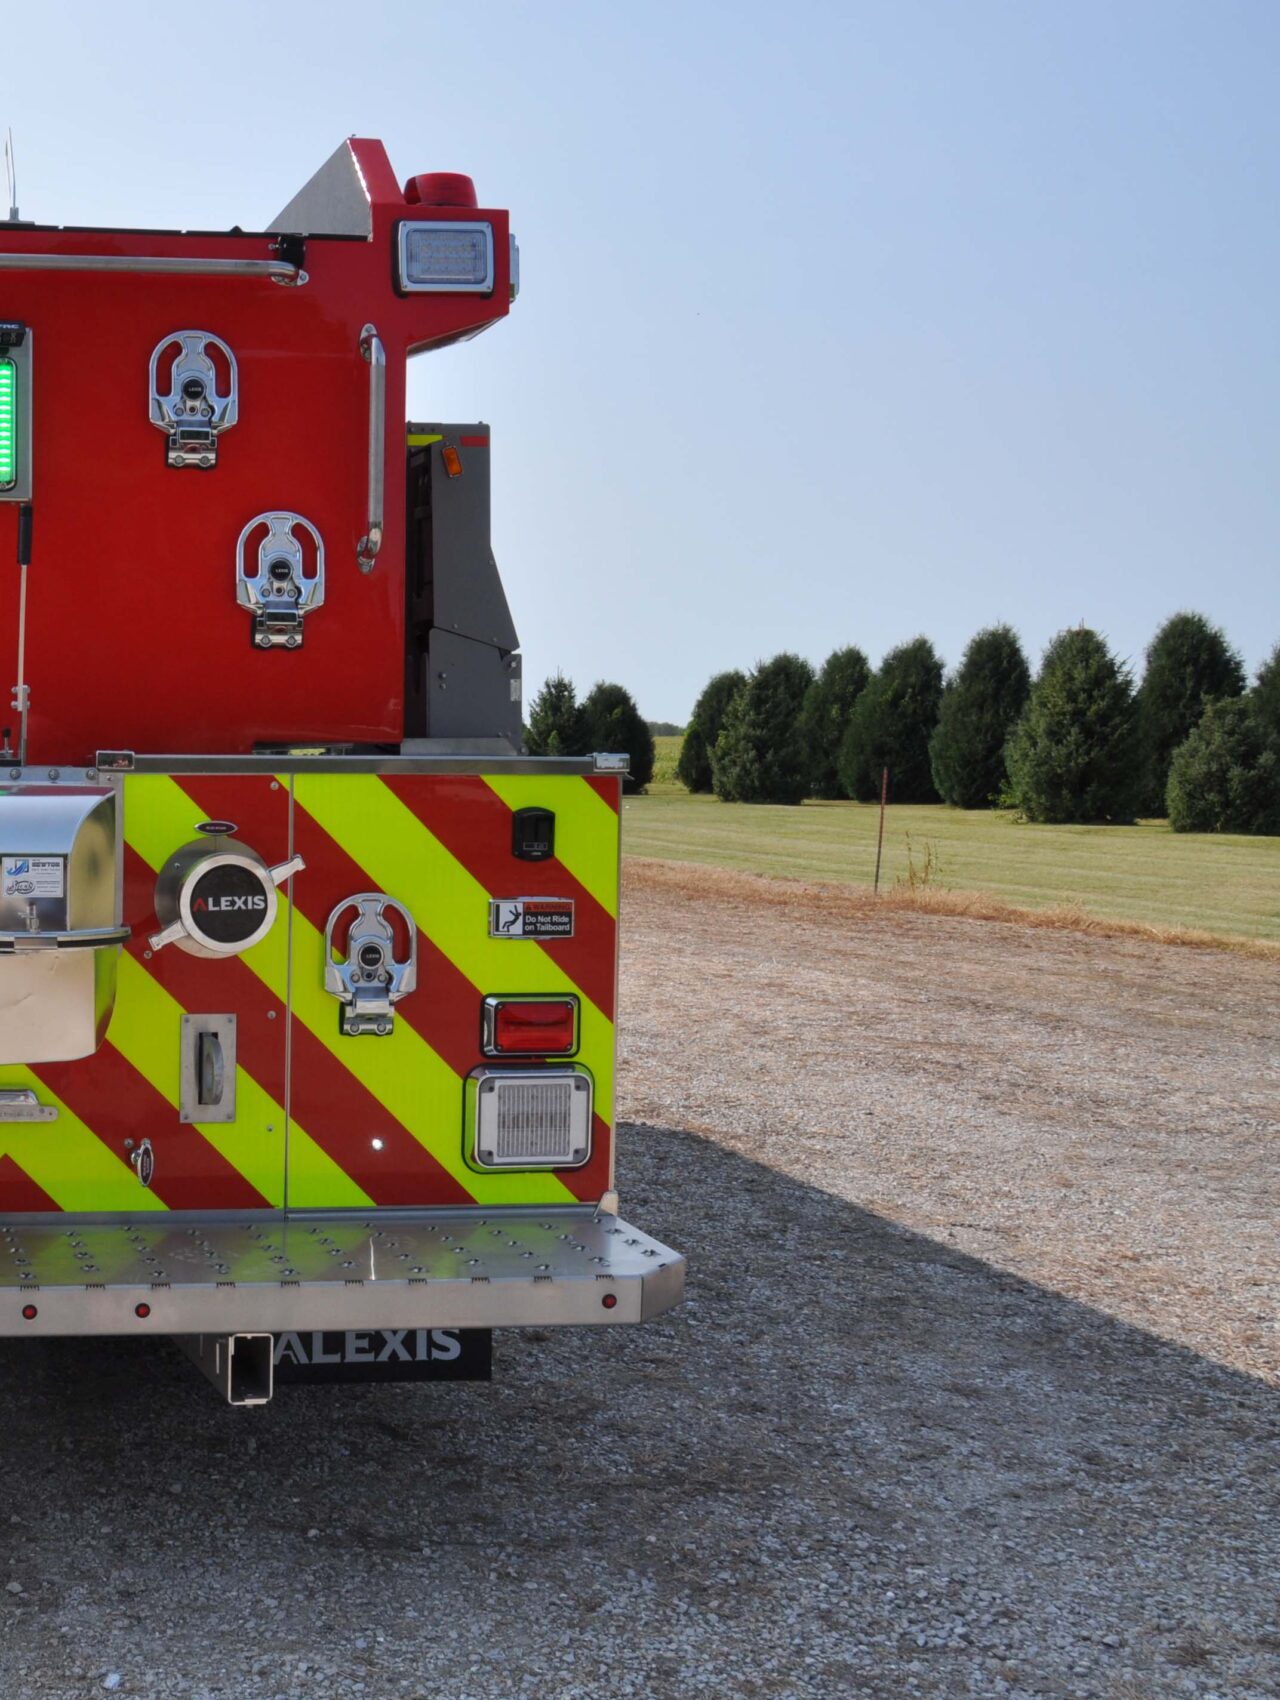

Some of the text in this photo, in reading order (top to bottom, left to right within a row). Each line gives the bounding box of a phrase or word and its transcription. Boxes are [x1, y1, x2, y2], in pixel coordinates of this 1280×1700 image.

[192, 895, 266, 912] ALEXIS
[525, 915, 570, 923] Do Not Ride
[536, 923, 570, 931] Tailboard
[273, 1329, 461, 1365] ALEXIS
